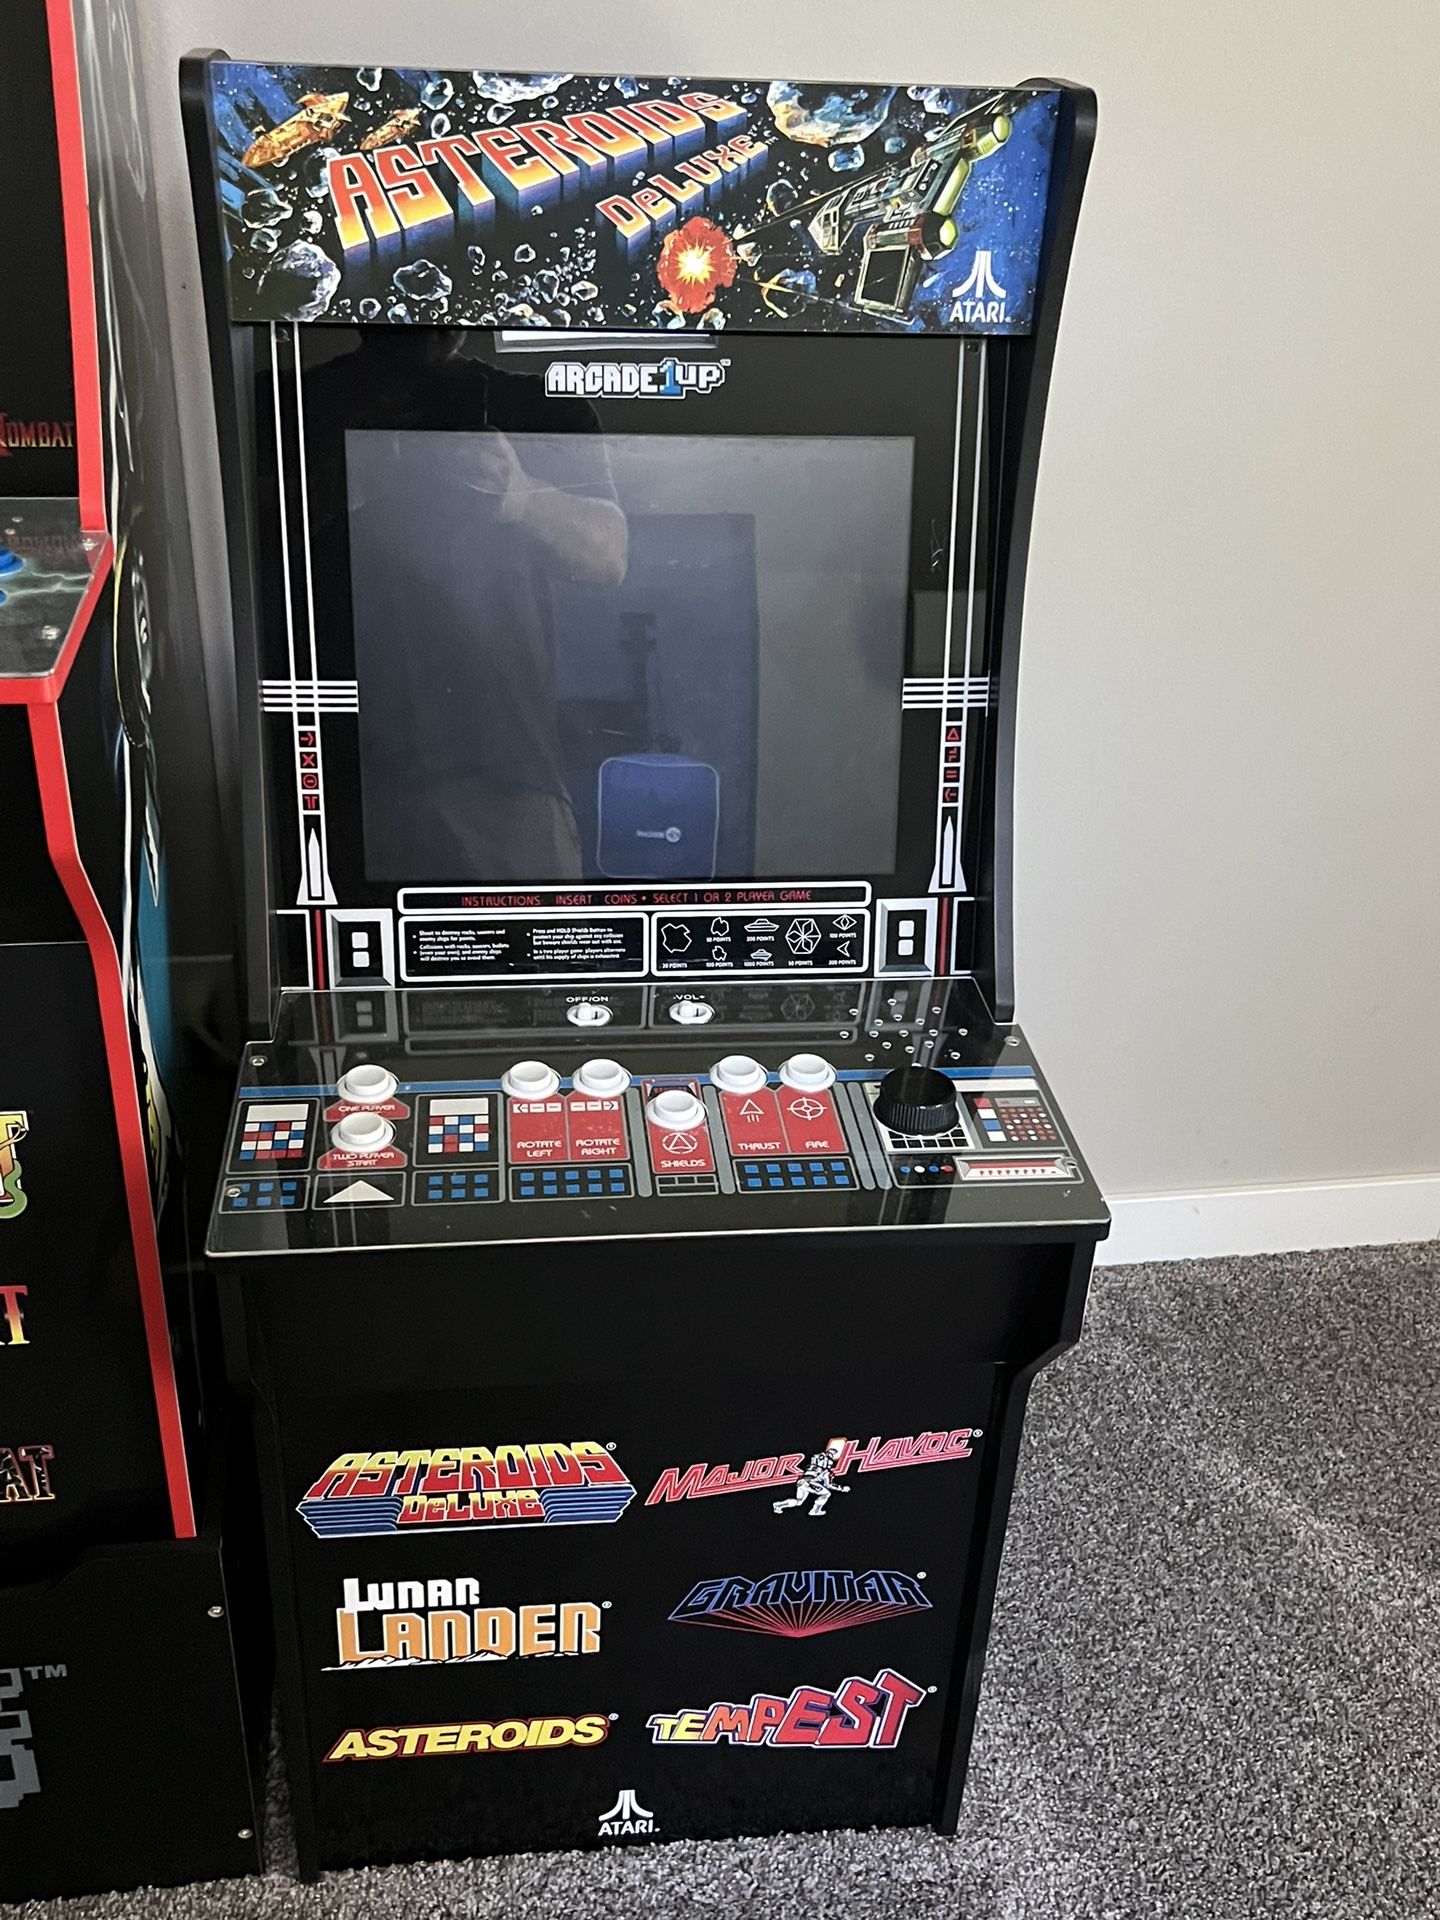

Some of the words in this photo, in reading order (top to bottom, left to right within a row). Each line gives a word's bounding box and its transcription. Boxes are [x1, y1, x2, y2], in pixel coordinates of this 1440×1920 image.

[326, 91, 748, 251] ASTEROIDS
[948, 300, 1007, 323] ATARI
[461, 894, 541, 907] INSTRUCTIONS
[555, 893, 593, 905] INSERT
[604, 893, 637, 905] COINS
[652, 891, 689, 904] SELECT
[693, 892, 699, 903] 1
[703, 891, 720, 903] OR
[724, 891, 732, 903] 2
[736, 890, 775, 902] PLAYER
[779, 889, 812, 901] GAME
[565, 995, 609, 1003] OFF/ON
[516, 1140, 562, 1149] ROTATE
[575, 1137, 621, 1147] ROTATE
[581, 1146, 617, 1156] RIGHT
[737, 1141, 782, 1151] THRUST
[804, 1140, 830, 1149] FIRE
[332, 1152, 358, 1161] TWO
[359, 1151, 395, 1159] PLAYER
[526, 1149, 553, 1158] LEFT
[346, 1159, 378, 1167] START
[660, 1158, 706, 1168] SHIELDS
[302, 1441, 630, 1500] ASTEROIDS
[645, 1452, 805, 1505] MAJOR
[833, 1428, 973, 1476] HAVOC
[343, 1577, 480, 1612] LUNAR
[668, 1569, 933, 1620] GRAVITAR
[337, 1601, 601, 1665] LANDER
[646, 1667, 927, 1748] TEMPEST
[325, 1714, 610, 1762] ASTEROIDS
[597, 1818, 654, 1837] ATARI
